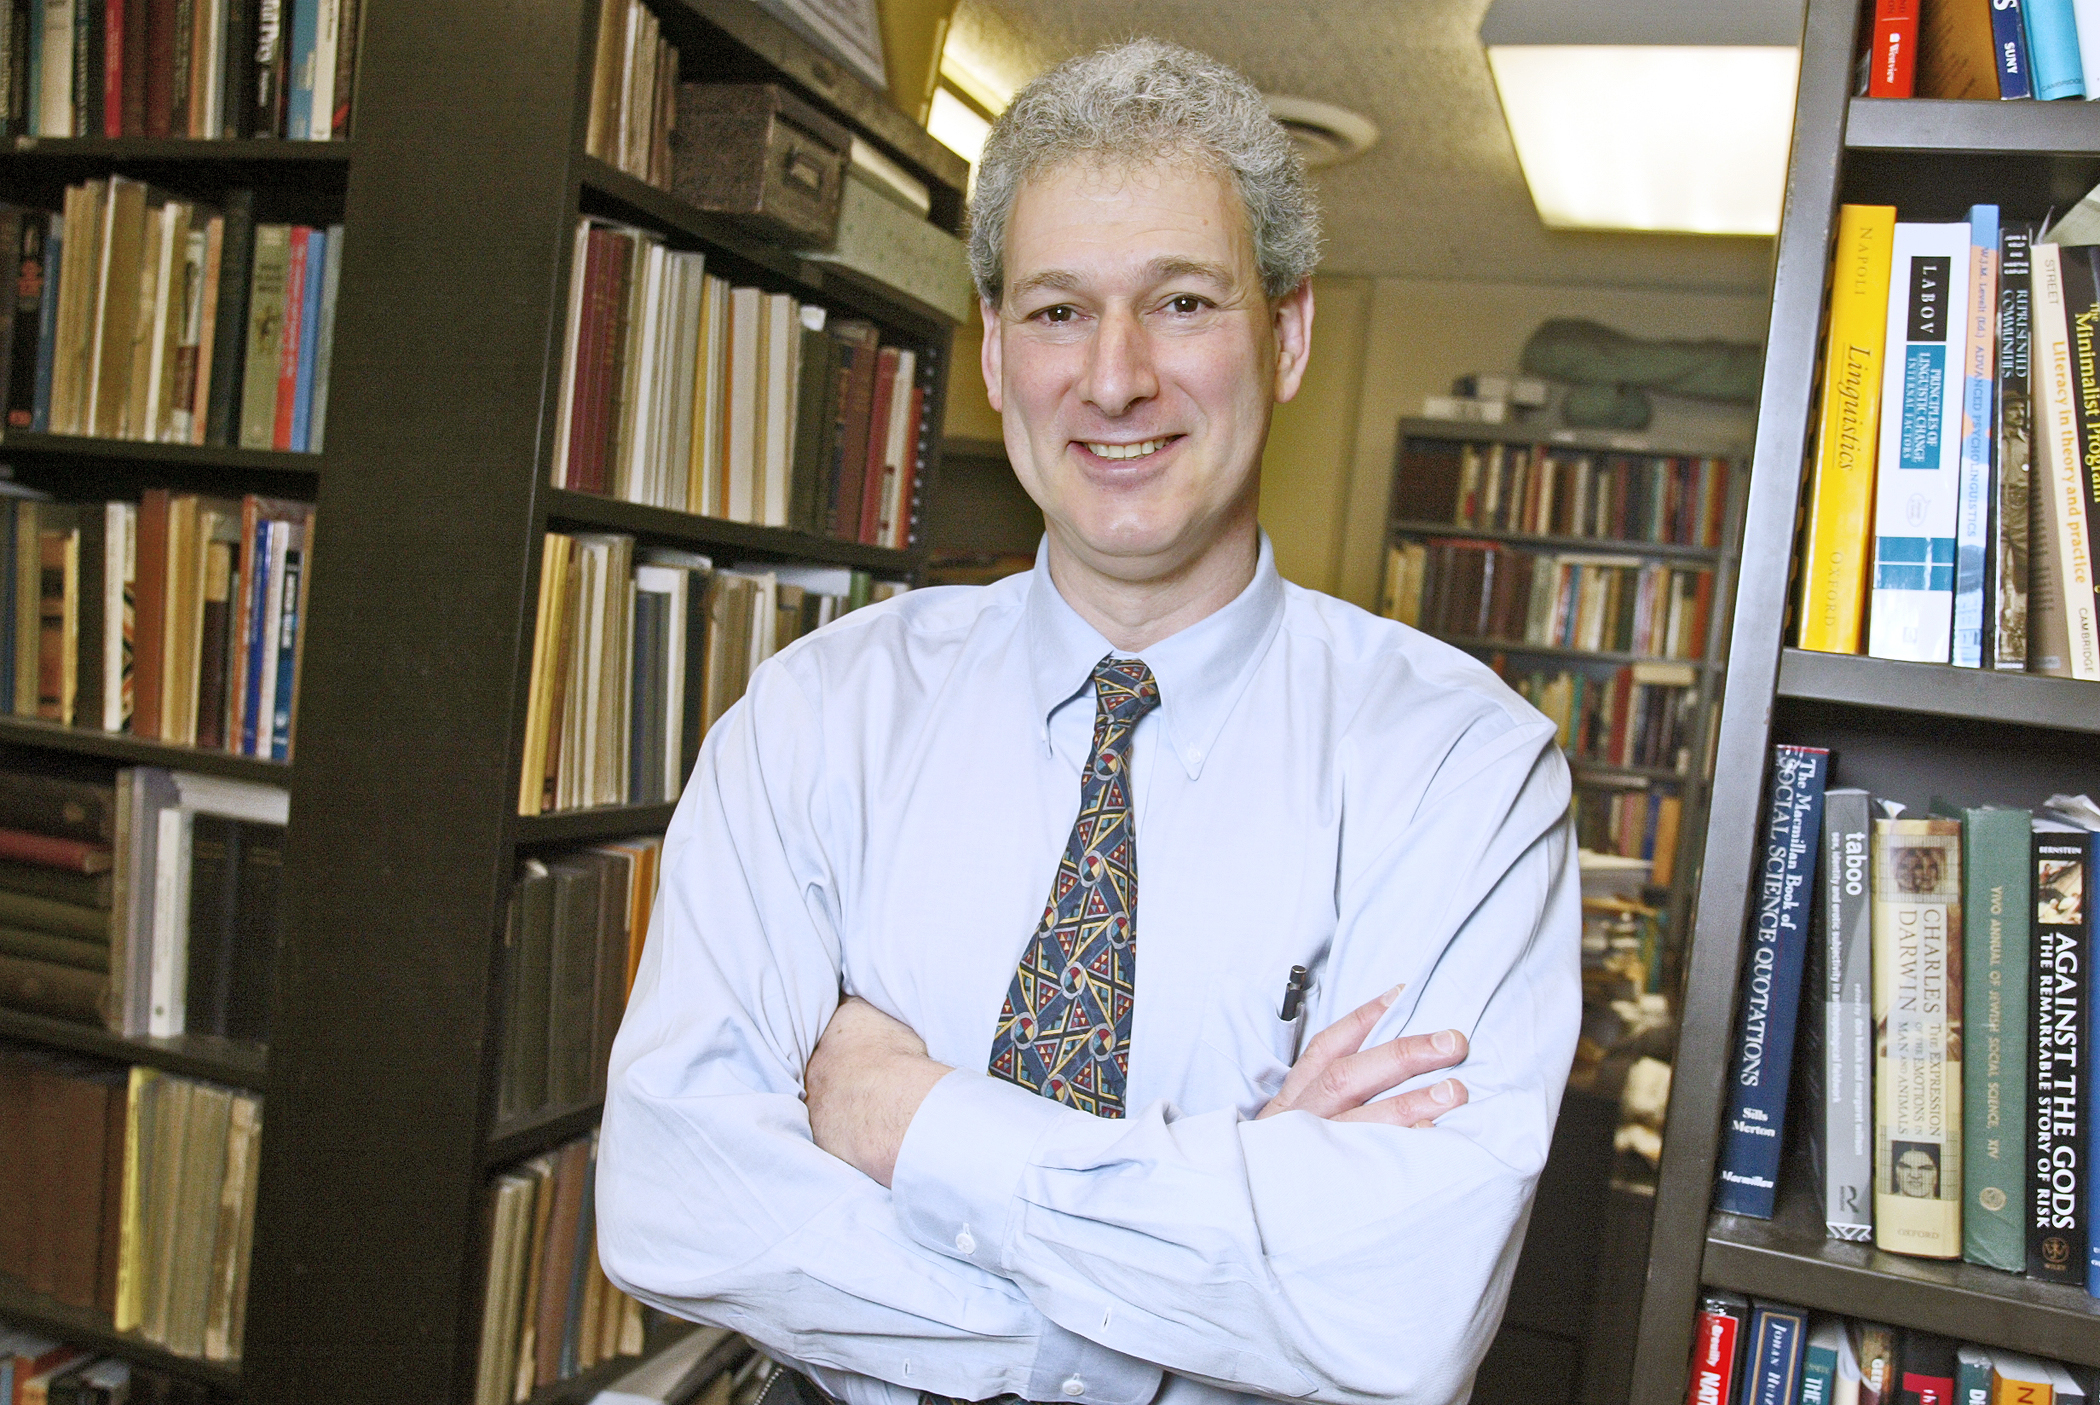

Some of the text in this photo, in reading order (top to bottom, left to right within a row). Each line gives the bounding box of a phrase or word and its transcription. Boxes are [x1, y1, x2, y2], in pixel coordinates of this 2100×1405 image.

[2003, 41, 2018, 75] SUNY
[1855, 226, 1874, 296] NAPOLI
[2044, 258, 2060, 305] STREET
[1919, 265, 1938, 334] LABOV
[1975, 316, 1987, 339] (Ed.)
[1977, 282, 1988, 313] Levelt
[2002, 289, 2015, 379] COMMUNITIES
[2015, 289, 2029, 378] REPRESENTED
[2075, 313, 2100, 417] Minimalist
[1837, 344, 1871, 472] Linguistics
[1902, 357, 1917, 459] INTERNAL FACTORS
[1913, 352, 1931, 463] LINGUISTIC CHANGE
[1926, 368, 1942, 447] PRINCIPLES OF
[1967, 345, 1985, 537] ADVANCED PSYCHOLINGUISTICS
[2053, 340, 2087, 584] Literacy in theory and practice
[1824, 551, 1844, 627] OXFORD
[2078, 607, 2094, 674] CAMBRIDGE
[1780, 758, 1817, 931] The Macmillan Book of
[1830, 850, 1842, 886] identity
[1845, 831, 1868, 896] taboo
[1740, 756, 1797, 1087] SOCIAL SCIENCE QUOTATIONS
[1831, 885, 1842, 903] and
[1831, 903, 1841, 931] erotic
[1990, 885, 2003, 916] YIVO
[1830, 931, 1842, 983] subjectivity
[1899, 909, 1918, 1012] DARWIN
[1923, 908, 1941, 1013] CHARLES
[1989, 918, 2002, 966] ANNUAL
[1989, 969, 2001, 986] OF
[1830, 993, 1842, 1062] anthropological
[1898, 1021, 1909, 1052] MAN
[1988, 990, 2001, 1033] JEWISH
[1831, 1063, 1843, 1103] fieldwork
[1913, 1057, 1925, 1122] EMOTIONS
[1987, 1037, 2000, 1077] SOCIAL
[2036, 932, 2054, 1229] THE REMARKABLE STORY OF RISK
[2051, 931, 2078, 1230] AGAINST THE GODS
[1742, 1107, 1769, 1122] Sills
[1897, 1075, 1909, 1135] ANIMALS
[1929, 1051, 1941, 1137] EXPRESSION
[1732, 1119, 1776, 1138] Merton
[1987, 1139, 2000, 1160] XIV
[1897, 1228, 1940, 1240] OXFORD
